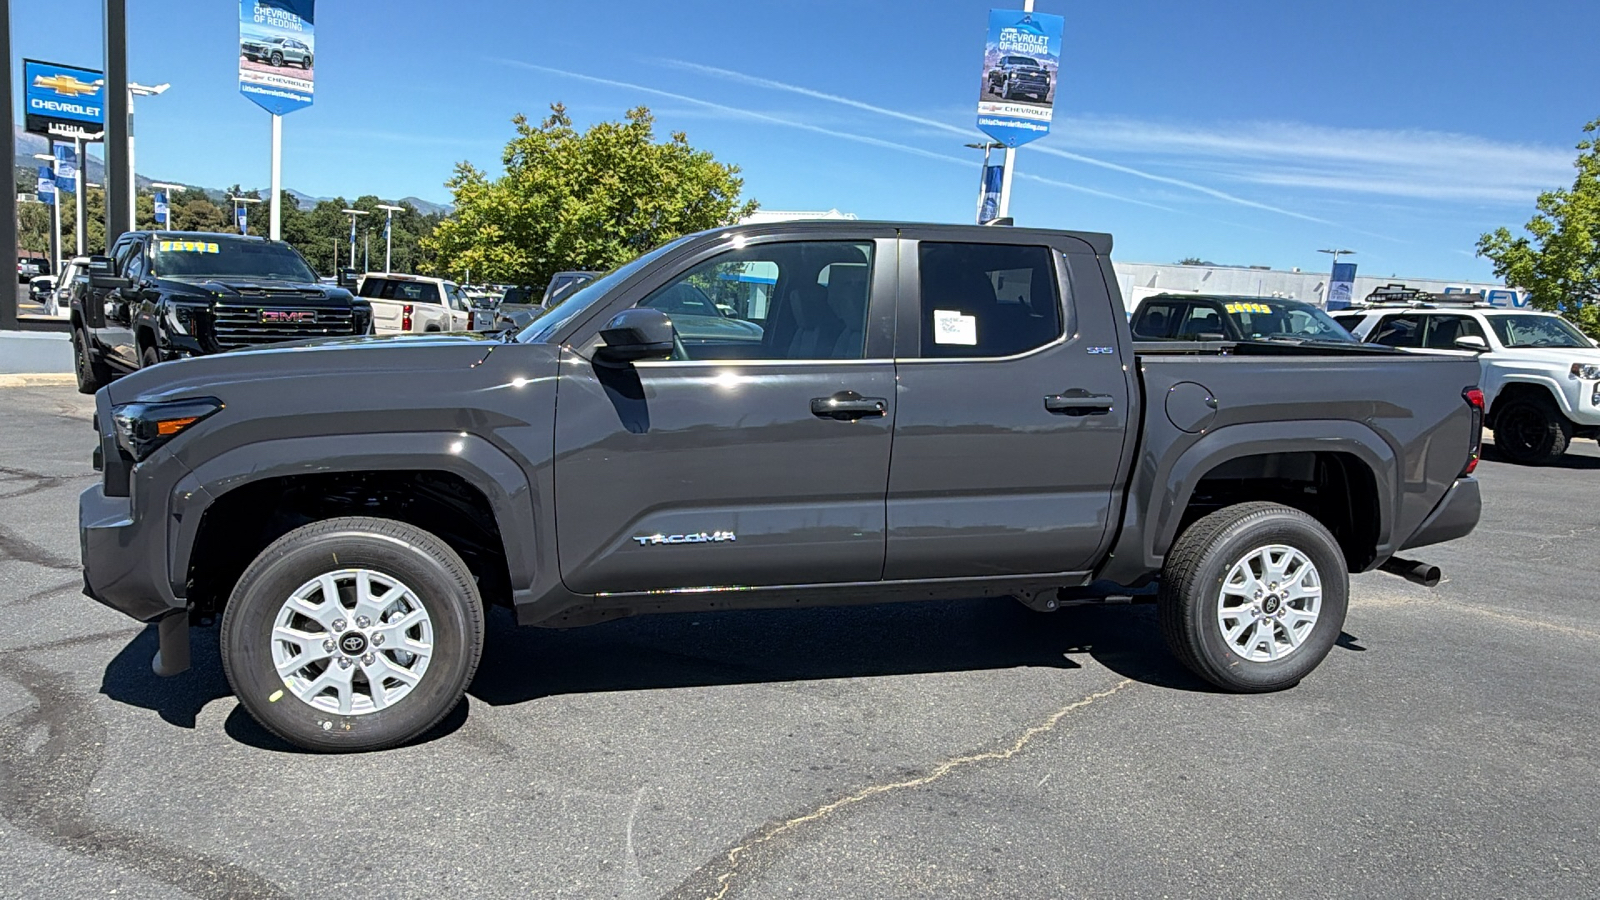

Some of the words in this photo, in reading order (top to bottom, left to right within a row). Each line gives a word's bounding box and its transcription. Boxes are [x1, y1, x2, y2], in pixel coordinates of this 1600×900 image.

[254, 15, 266, 23] OF
[267, 16, 303, 31] REDDING
[1000, 32, 1049, 46] CHEVROLET
[999, 41, 1011, 51] OF
[1011, 42, 1048, 55] REDDING
[267, 76, 311, 89] CHEVROLET
[31, 98, 101, 117] CHEVROLET
[1004, 106, 1049, 117] CHEVROLET
[48, 122, 85, 134] LITHIA
[262, 311, 315, 323] GMC
[632, 531, 736, 545] TACOMA
